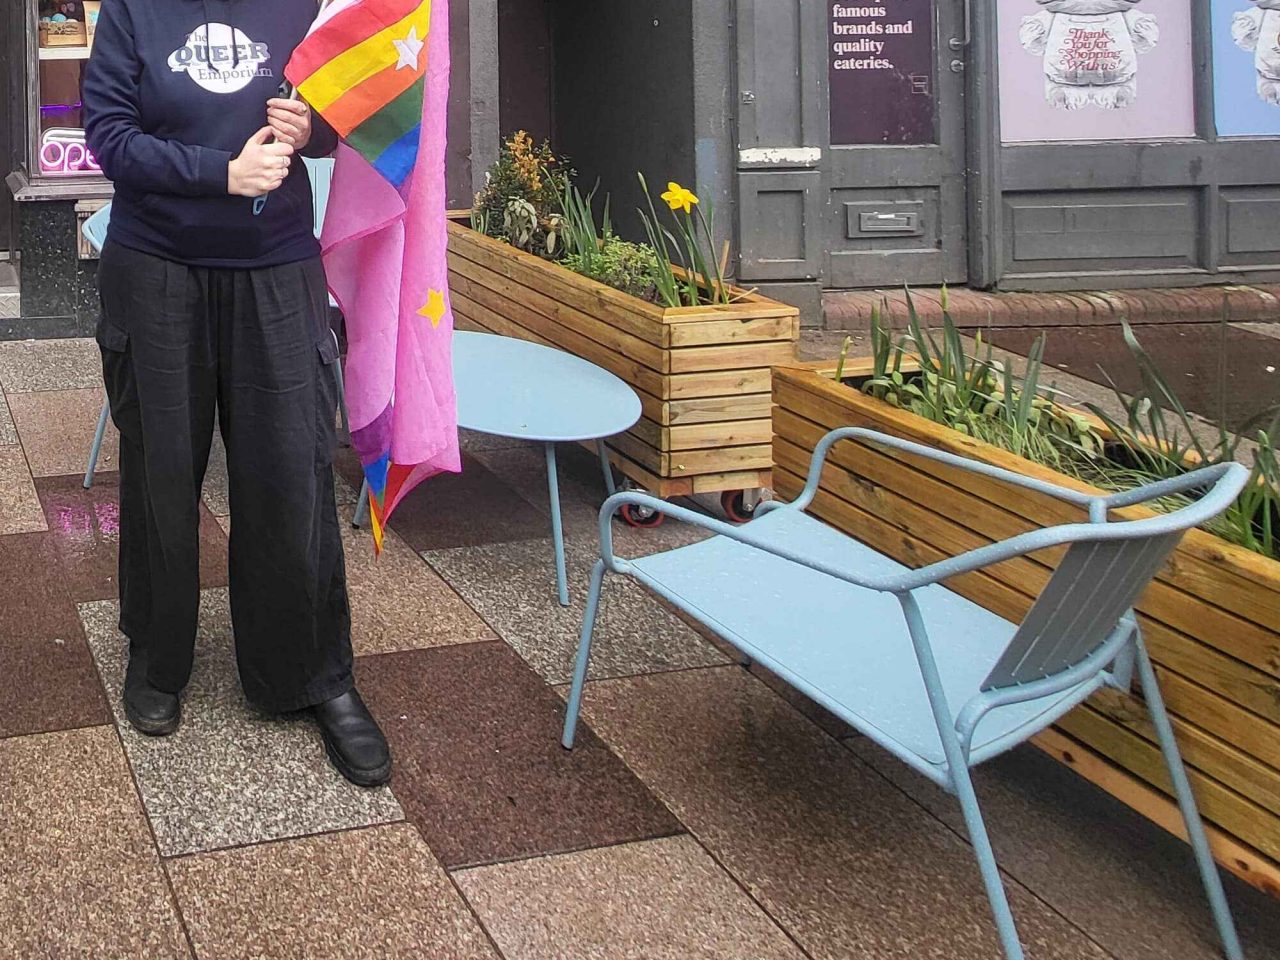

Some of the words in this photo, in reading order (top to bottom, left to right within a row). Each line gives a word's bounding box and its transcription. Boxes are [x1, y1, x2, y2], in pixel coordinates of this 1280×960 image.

[833, 4, 886, 17] famous
[833, 21, 883, 35] brands
[885, 20, 913, 34] and
[1069, 27, 1116, 43] Thank
[833, 38, 885, 55] quality
[1063, 38, 1091, 50] You
[1087, 38, 1110, 52] for
[174, 43, 271, 66] QUEER
[1058, 48, 1124, 61] Shopping
[833, 56, 894, 70] eateries.
[198, 66, 273, 83] Emporium
